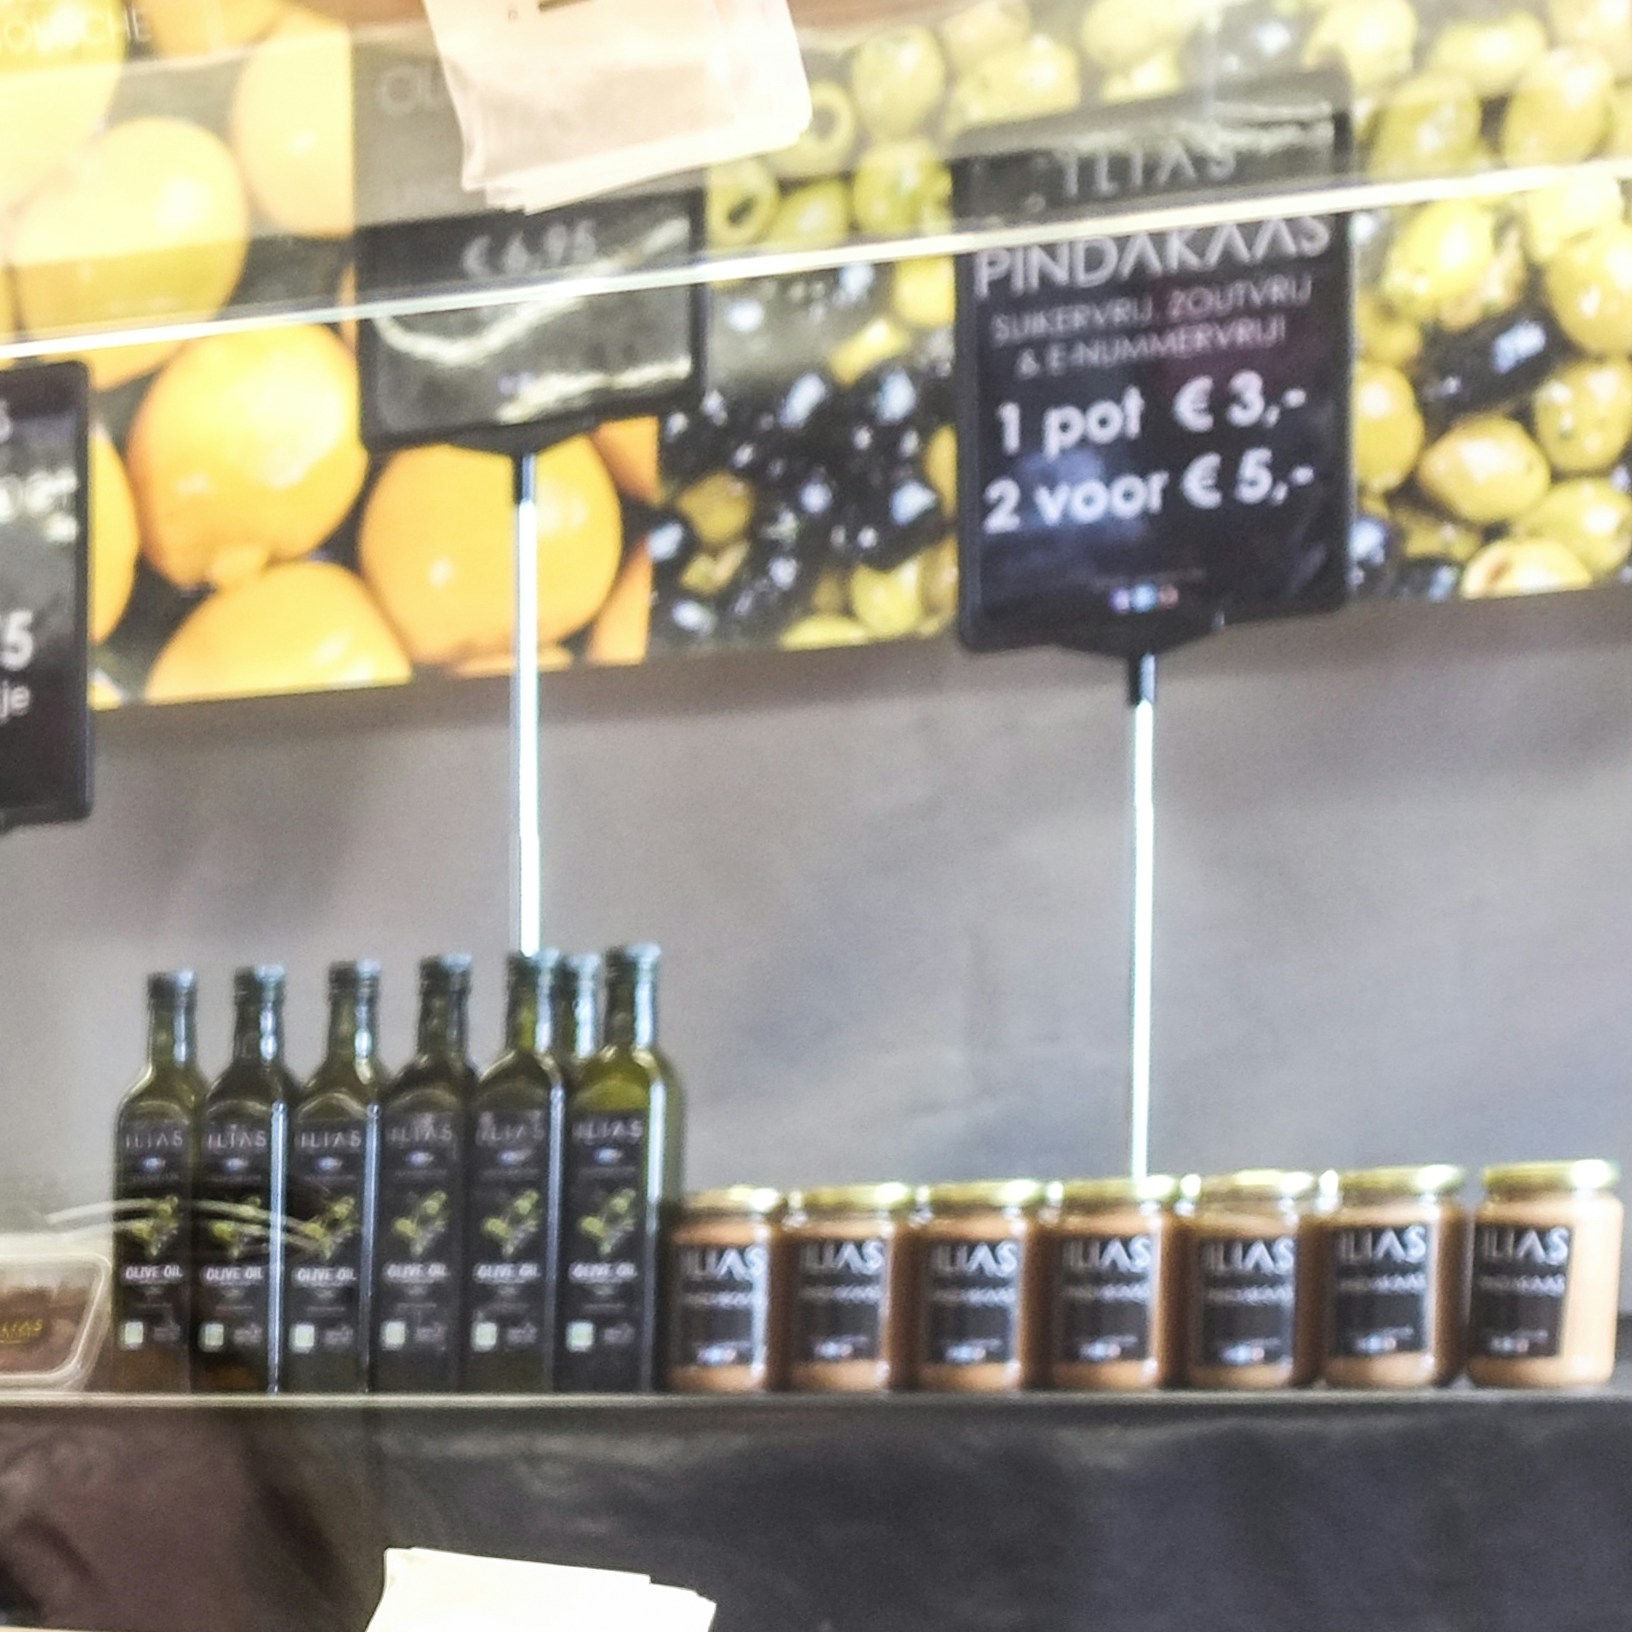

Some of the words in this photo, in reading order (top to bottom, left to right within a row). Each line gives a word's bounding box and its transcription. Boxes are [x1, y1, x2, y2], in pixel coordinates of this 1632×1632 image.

[972, 216, 1333, 299] PINDAKAAS
[997, 402, 1021, 456] 1
[1042, 385, 1146, 462] pot
[1174, 374, 1215, 433] €
[983, 478, 1022, 535] 2
[1036, 471, 1170, 526] voor
[1181, 453, 1223, 509] €
[1204, 1237, 1296, 1275] ILIAS
[1339, 1225, 1428, 1263] ILIAS
[1481, 1226, 1570, 1266] ILIAS
